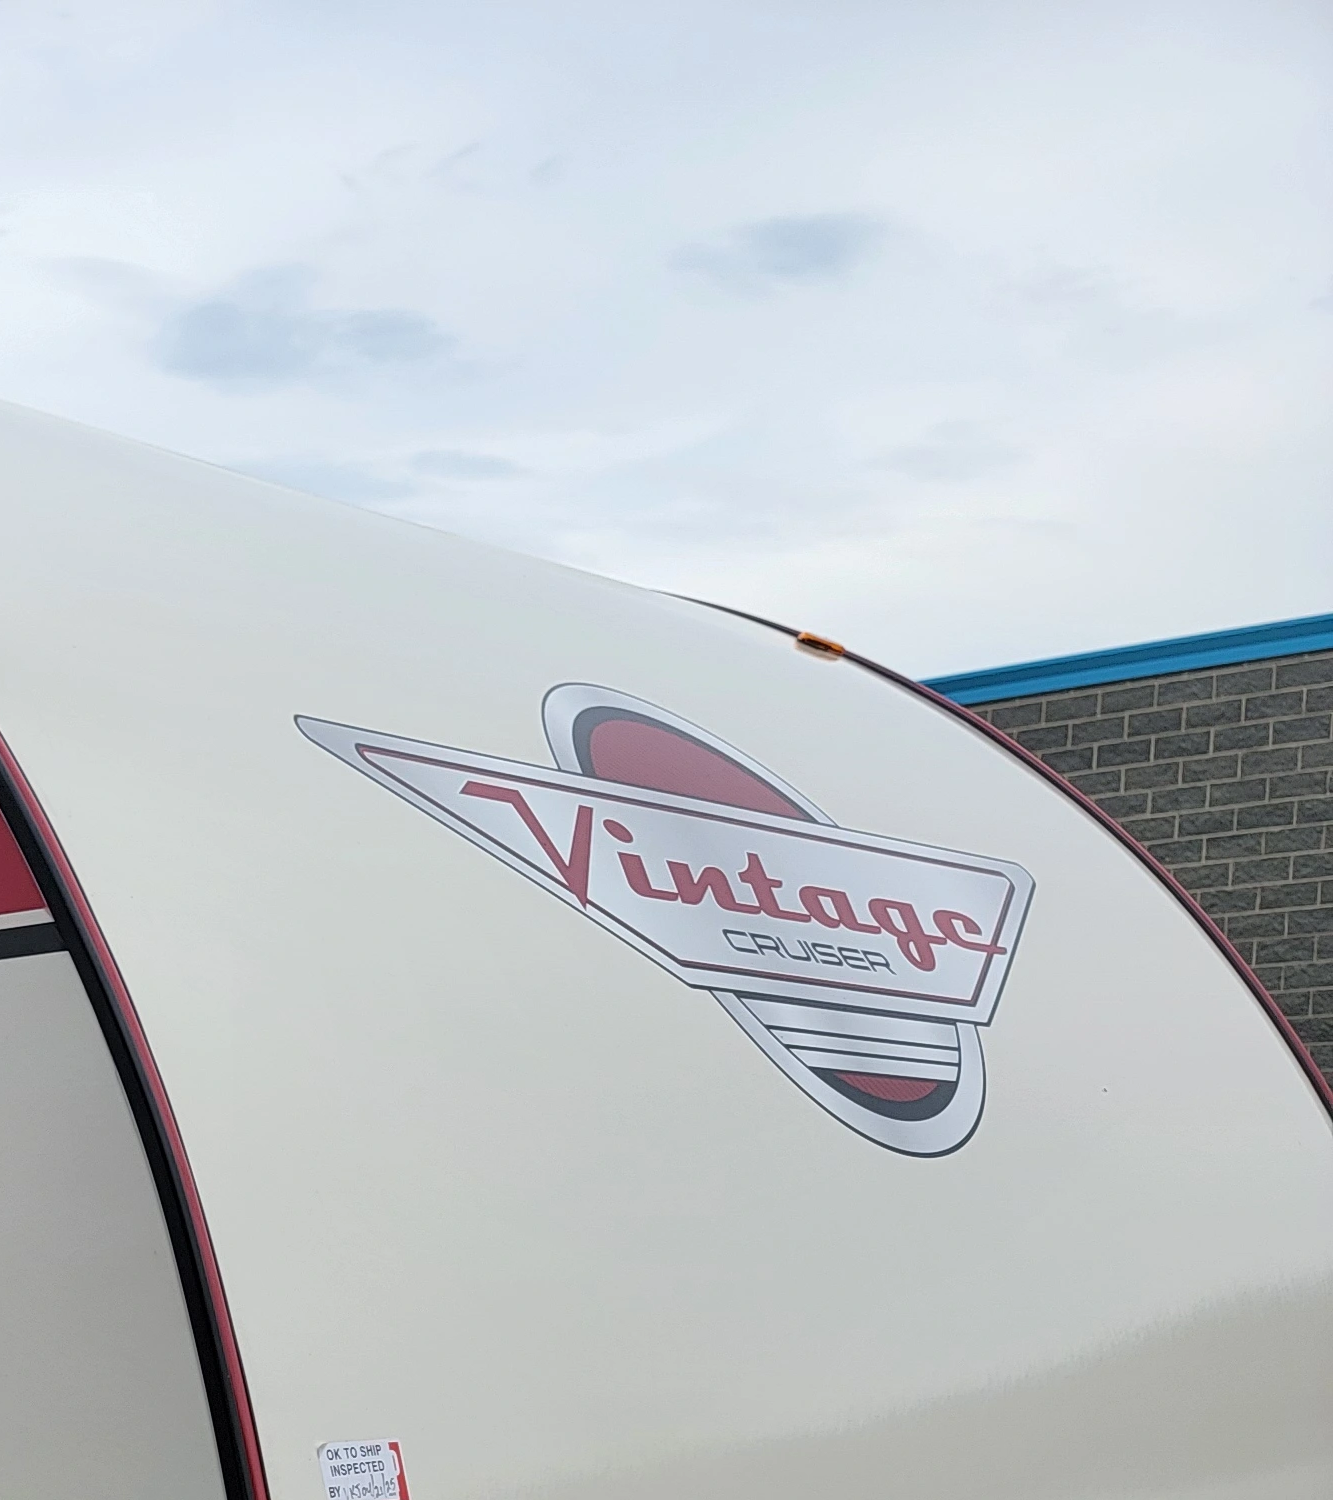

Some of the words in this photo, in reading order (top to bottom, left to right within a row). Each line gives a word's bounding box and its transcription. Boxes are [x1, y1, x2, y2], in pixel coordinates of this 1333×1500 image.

[459, 780, 1007, 971] Vintage
[722, 929, 897, 975] CRUISER
[326, 1448, 342, 1460] OK
[343, 1446, 357, 1459] TO
[359, 1444, 382, 1457] SHIP
[330, 1460, 385, 1477] INSPECTED
[328, 1485, 340, 1498] BY
